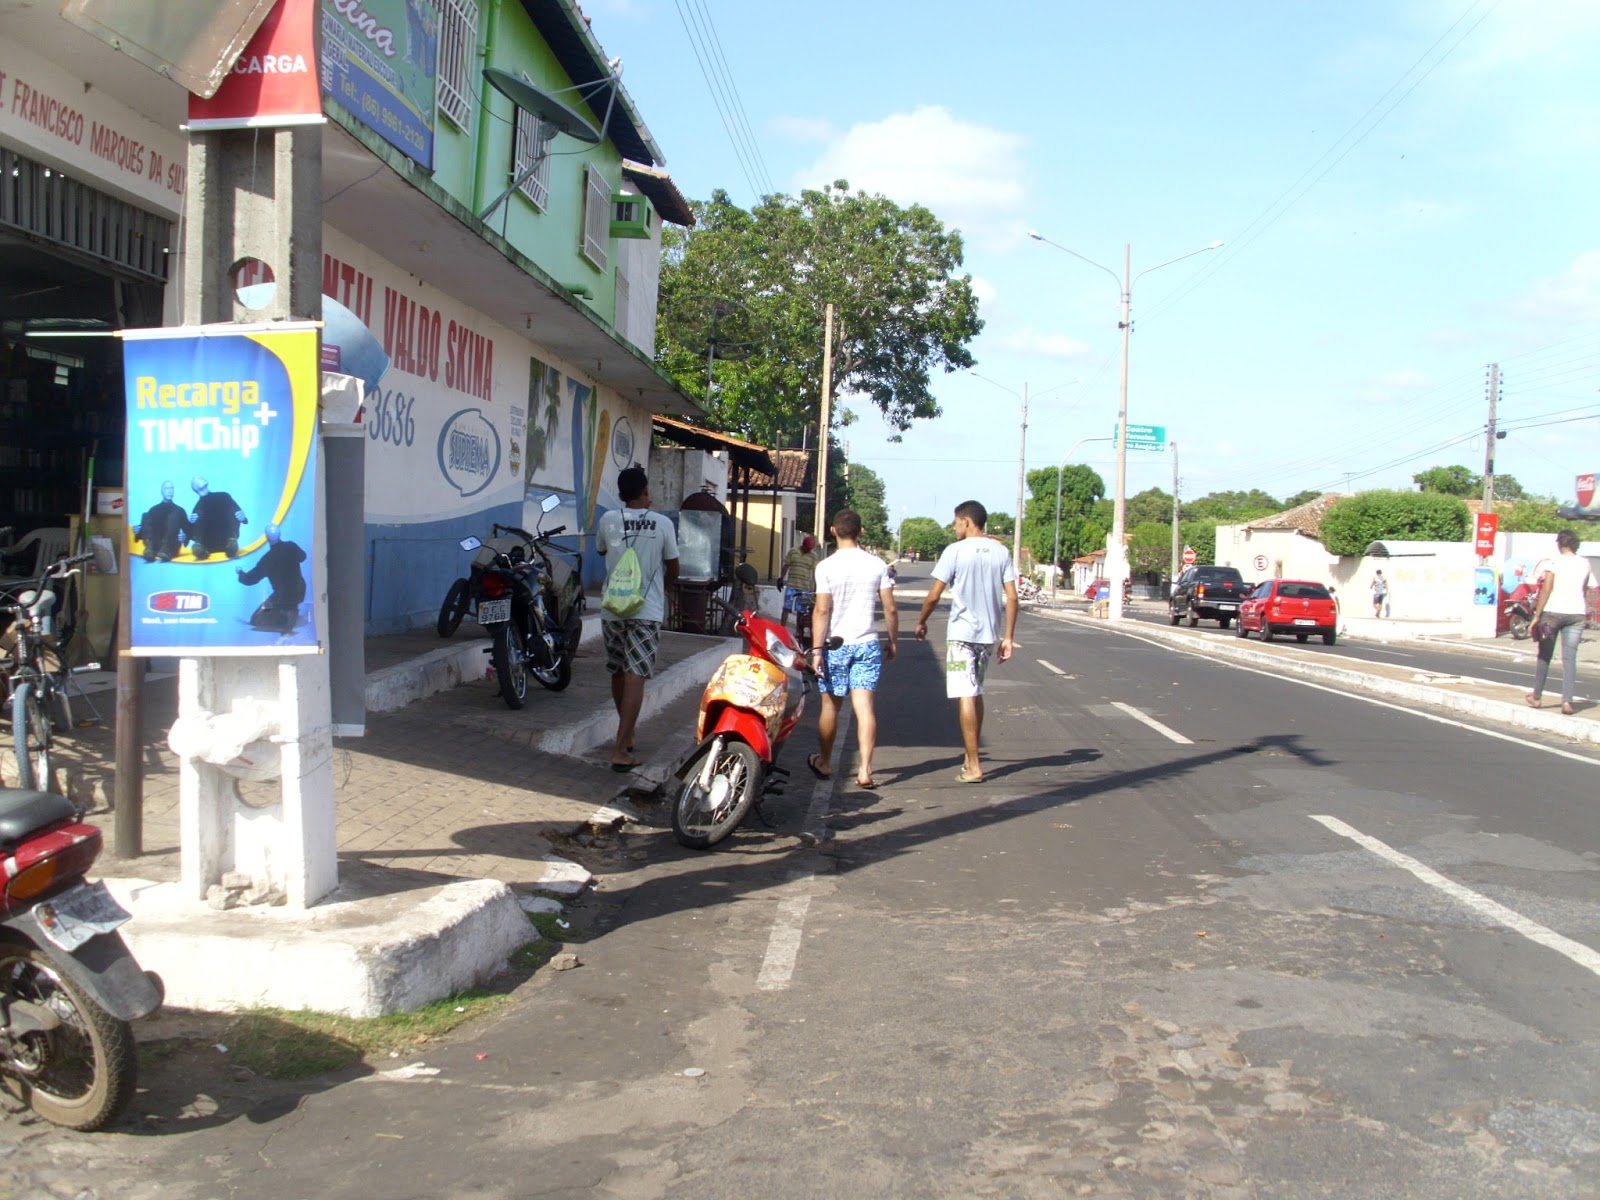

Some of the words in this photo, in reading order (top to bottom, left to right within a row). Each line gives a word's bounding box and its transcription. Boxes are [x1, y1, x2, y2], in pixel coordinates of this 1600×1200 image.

[333, 0, 396, 57] ina
[230, 54, 307, 74] CARGA
[12, 78, 84, 146] FRANCISCO
[90, 121, 144, 175] MARQUES
[149, 150, 162, 185] DA
[384, 286, 442, 383] VALDO
[445, 319, 494, 402] SKINA
[136, 376, 259, 414] Recarga
[449, 429, 491, 477] SUPREMA
[175, 595, 203, 610] TIM
